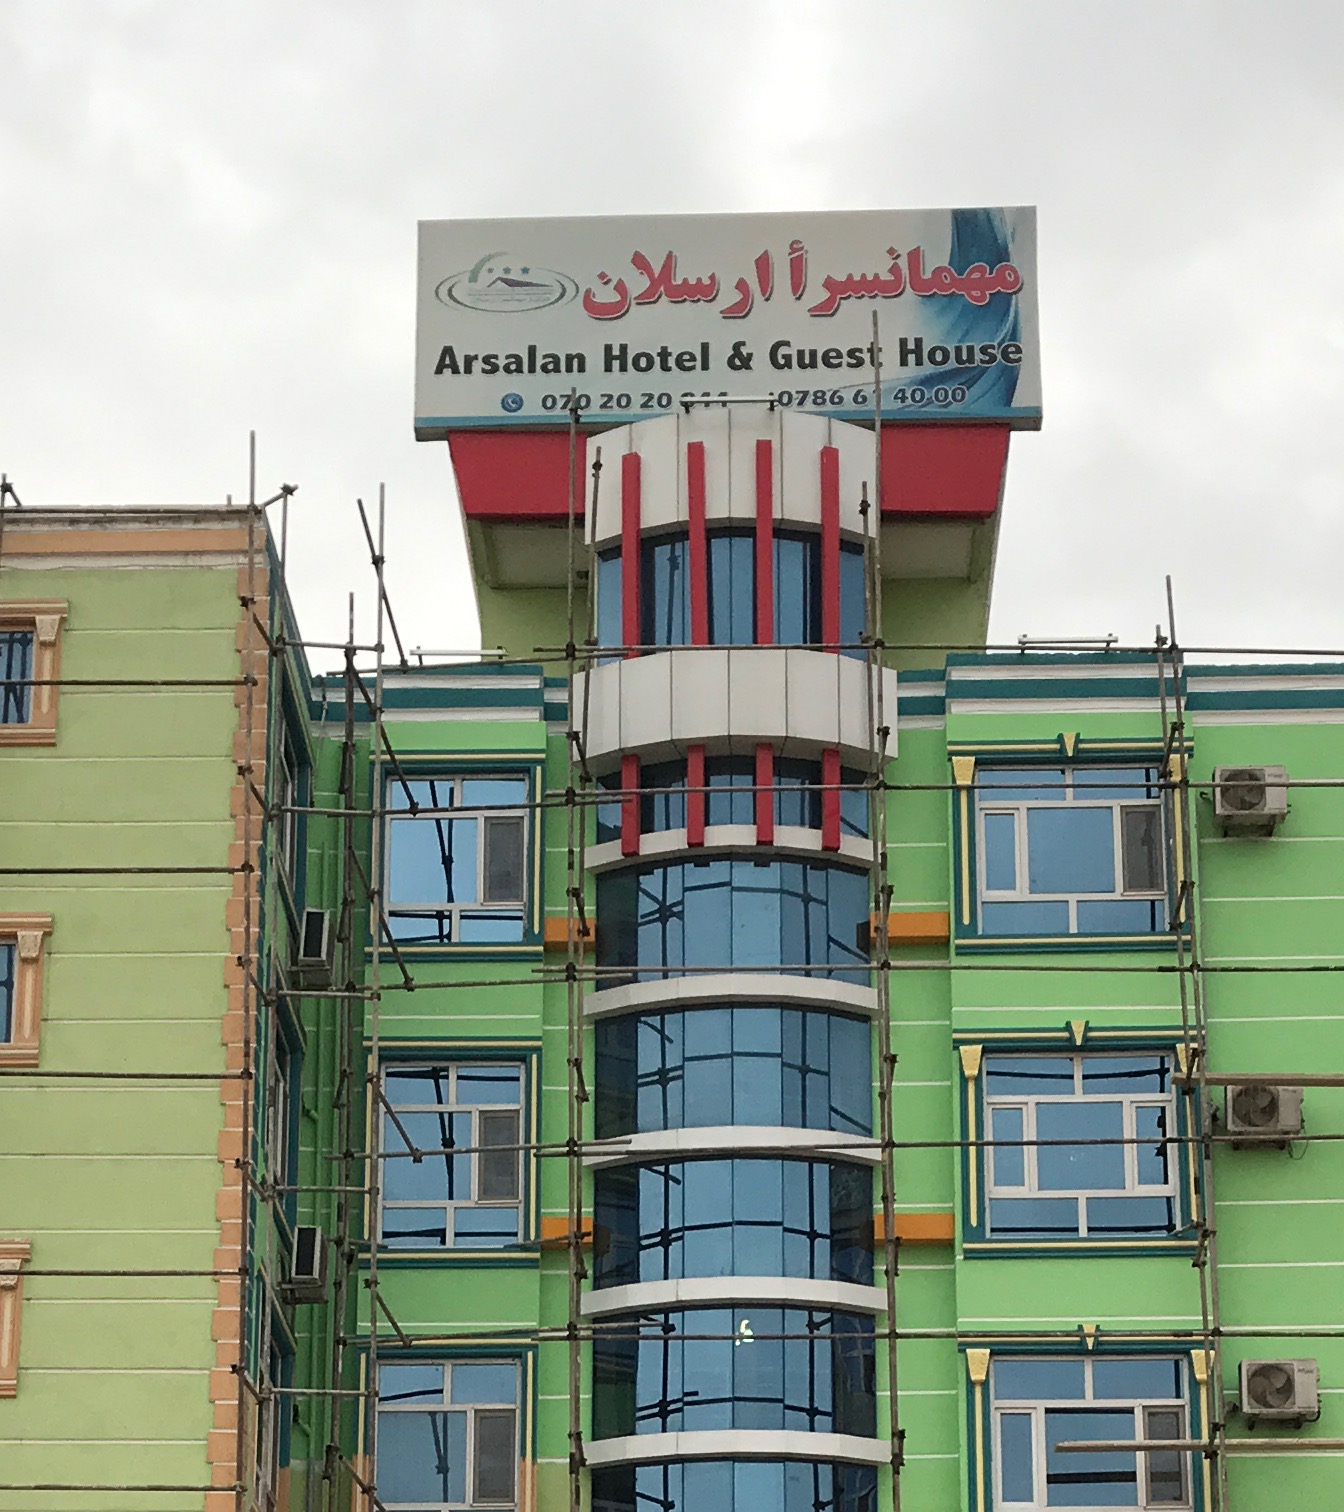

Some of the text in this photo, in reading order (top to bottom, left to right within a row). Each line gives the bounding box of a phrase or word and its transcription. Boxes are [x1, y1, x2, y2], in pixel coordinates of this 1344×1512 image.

[582, 249, 773, 321] ارسلان
[434, 336, 1023, 375] Arsalan Hotel & Guest House
[541, 393, 591, 410] 070
[599, 393, 632, 410] 20
[639, 392, 672, 409] 20
[777, 388, 845, 407] 0786
